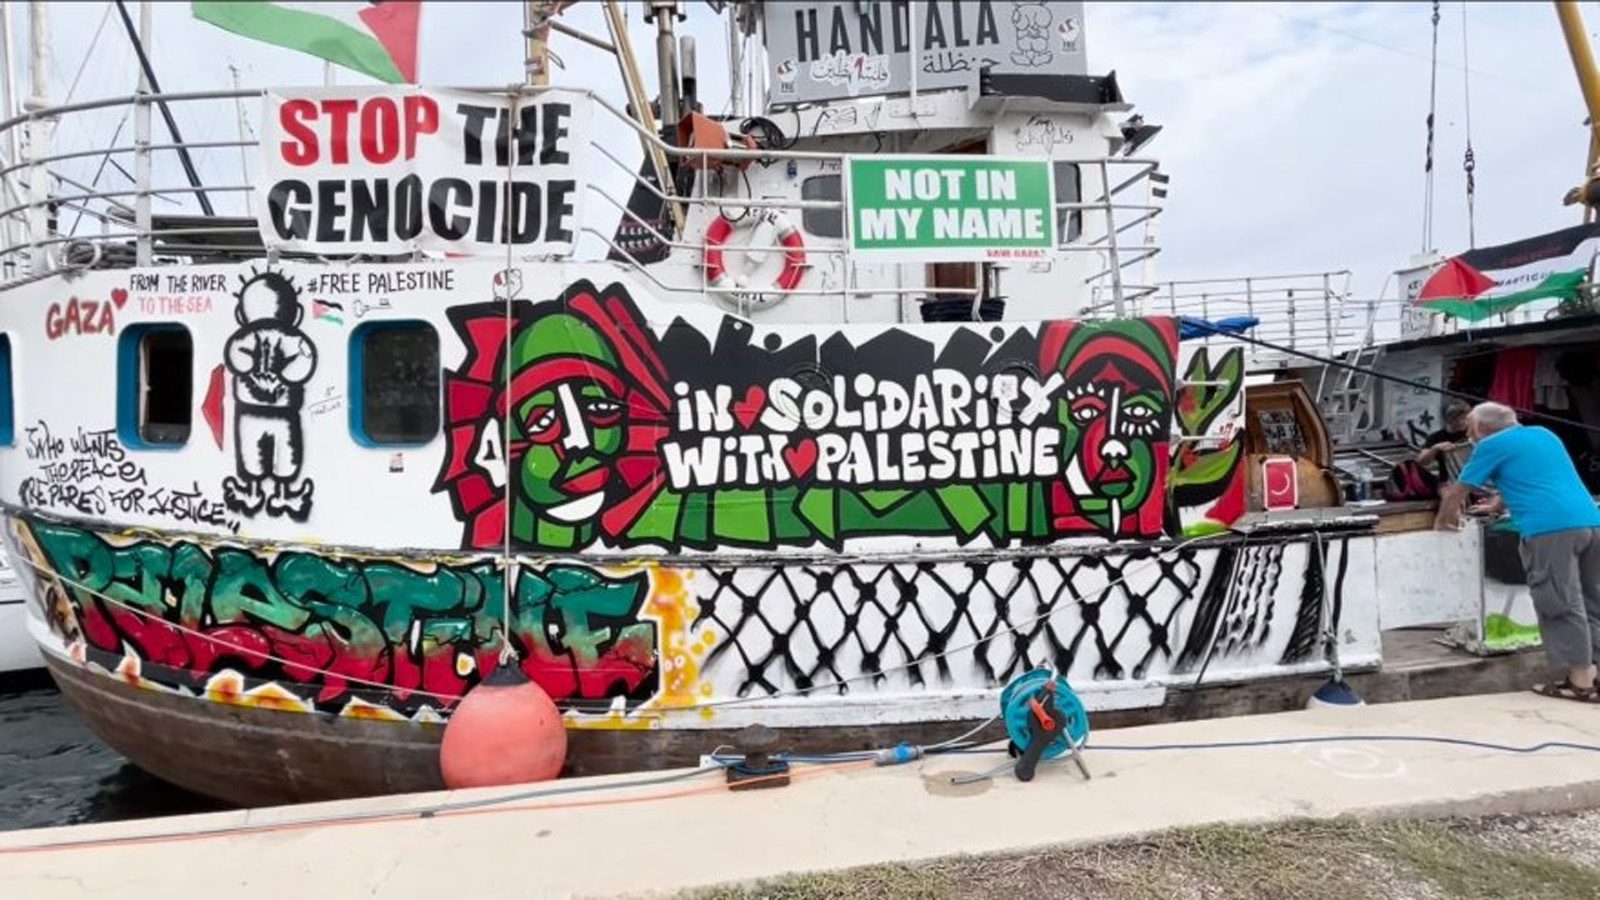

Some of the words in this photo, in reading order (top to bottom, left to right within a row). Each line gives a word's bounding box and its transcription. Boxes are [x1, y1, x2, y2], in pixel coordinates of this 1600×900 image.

[795, 0, 999, 62] HANDALA
[279, 95, 439, 167] STOP
[456, 103, 572, 166] THE
[883, 168, 965, 202] NOT
[976, 168, 1017, 202] IN
[267, 172, 576, 245] GENOCIDE
[859, 208, 923, 241] MY
[933, 207, 1045, 240] NAME
[130, 274, 160, 292] FROM
[166, 275, 188, 293] THE
[191, 274, 227, 292] RIVER
[307, 273, 361, 294] #FREE
[368, 269, 455, 293] PALESTINE
[45, 295, 115, 341] GAZA
[138, 297, 157, 314] TO
[159, 297, 186, 314] THE
[186, 296, 213, 314] SEA
[109, 487, 145, 513] FOR
